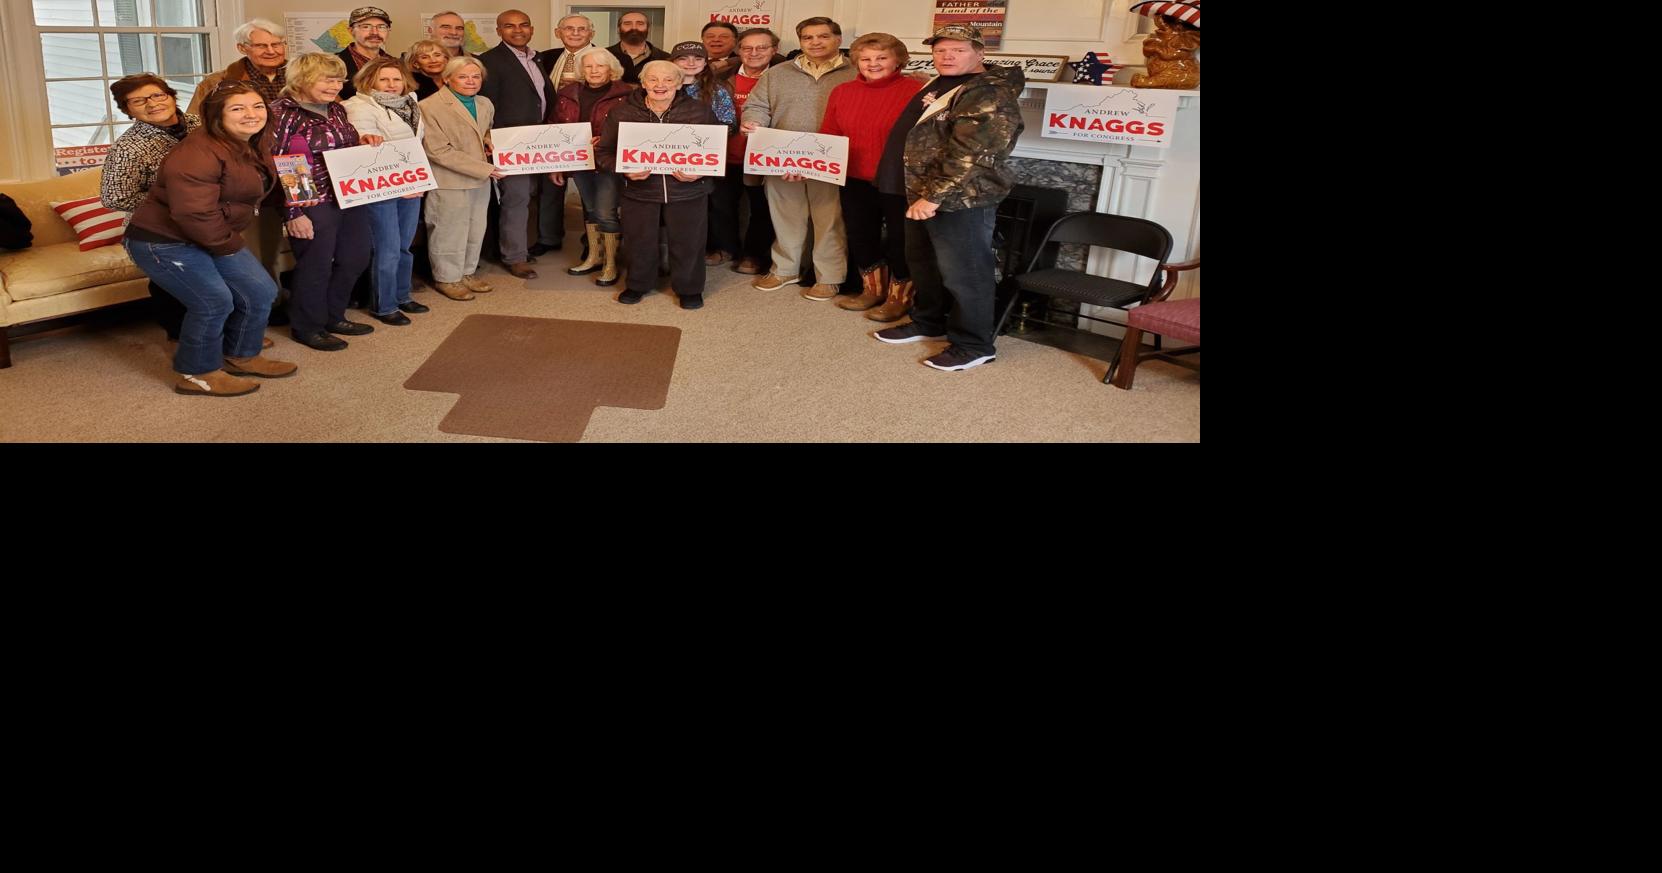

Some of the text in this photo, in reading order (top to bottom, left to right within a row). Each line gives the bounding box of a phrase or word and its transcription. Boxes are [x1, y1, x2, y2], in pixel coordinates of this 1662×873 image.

[710, 13, 771, 25] KNAGGS
[983, 58, 1060, 68] mazing Grace
[1049, 113, 1165, 136] KNAGGS
[1090, 133, 1135, 141] CONGRESS
[498, 149, 589, 166] KNAGGS
[622, 149, 719, 166] KNAGGS
[748, 152, 841, 175] KNAGGS
[367, 162, 400, 174] ANDREW
[339, 167, 429, 197] KNAGGS
[367, 186, 416, 200] FOR CONGRESS
